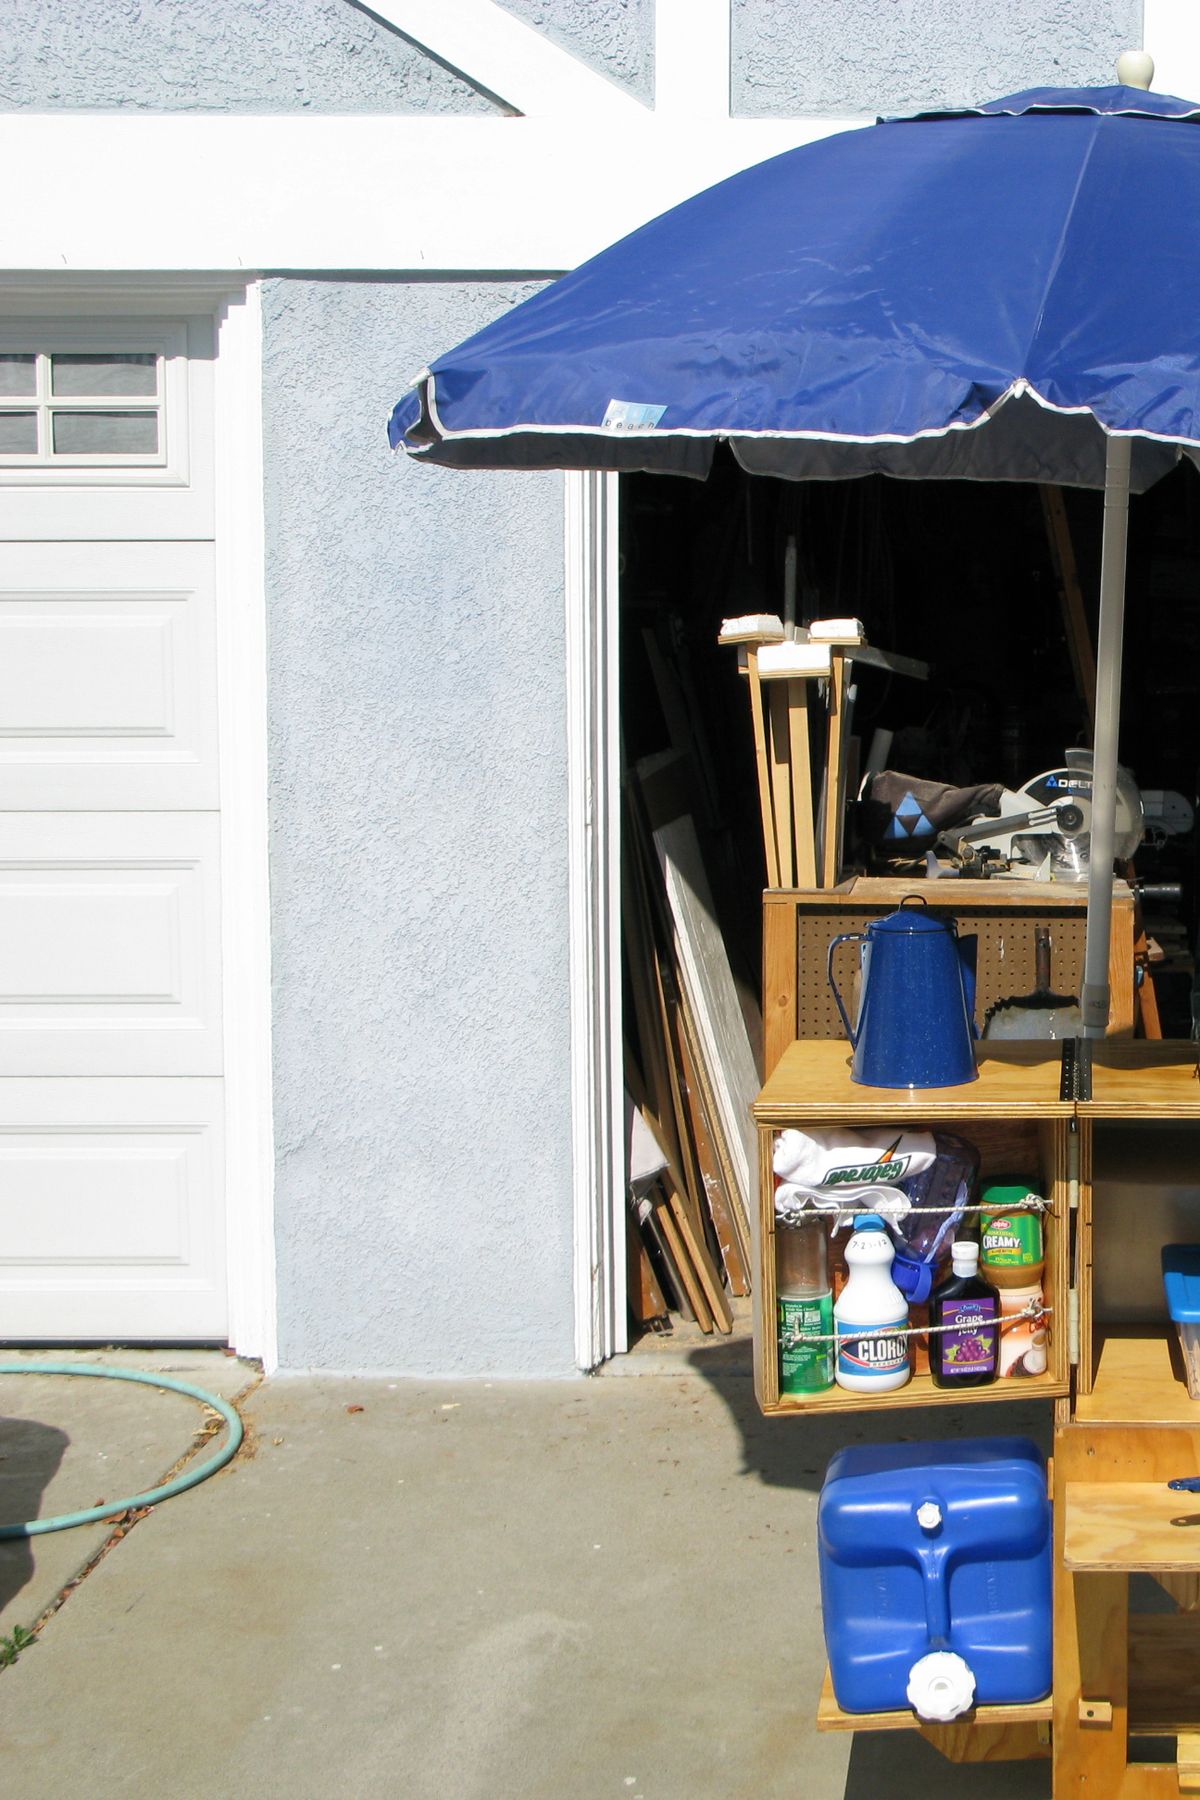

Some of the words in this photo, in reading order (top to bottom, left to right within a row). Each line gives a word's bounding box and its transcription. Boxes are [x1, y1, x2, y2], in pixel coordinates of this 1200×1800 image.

[1058, 779, 1093, 789] DELT
[826, 1160, 904, 1185] Gatorade
[982, 1234, 1021, 1250] CREAMY
[955, 1314, 984, 1325] Grape
[857, 1333, 908, 1361] CLOROX
